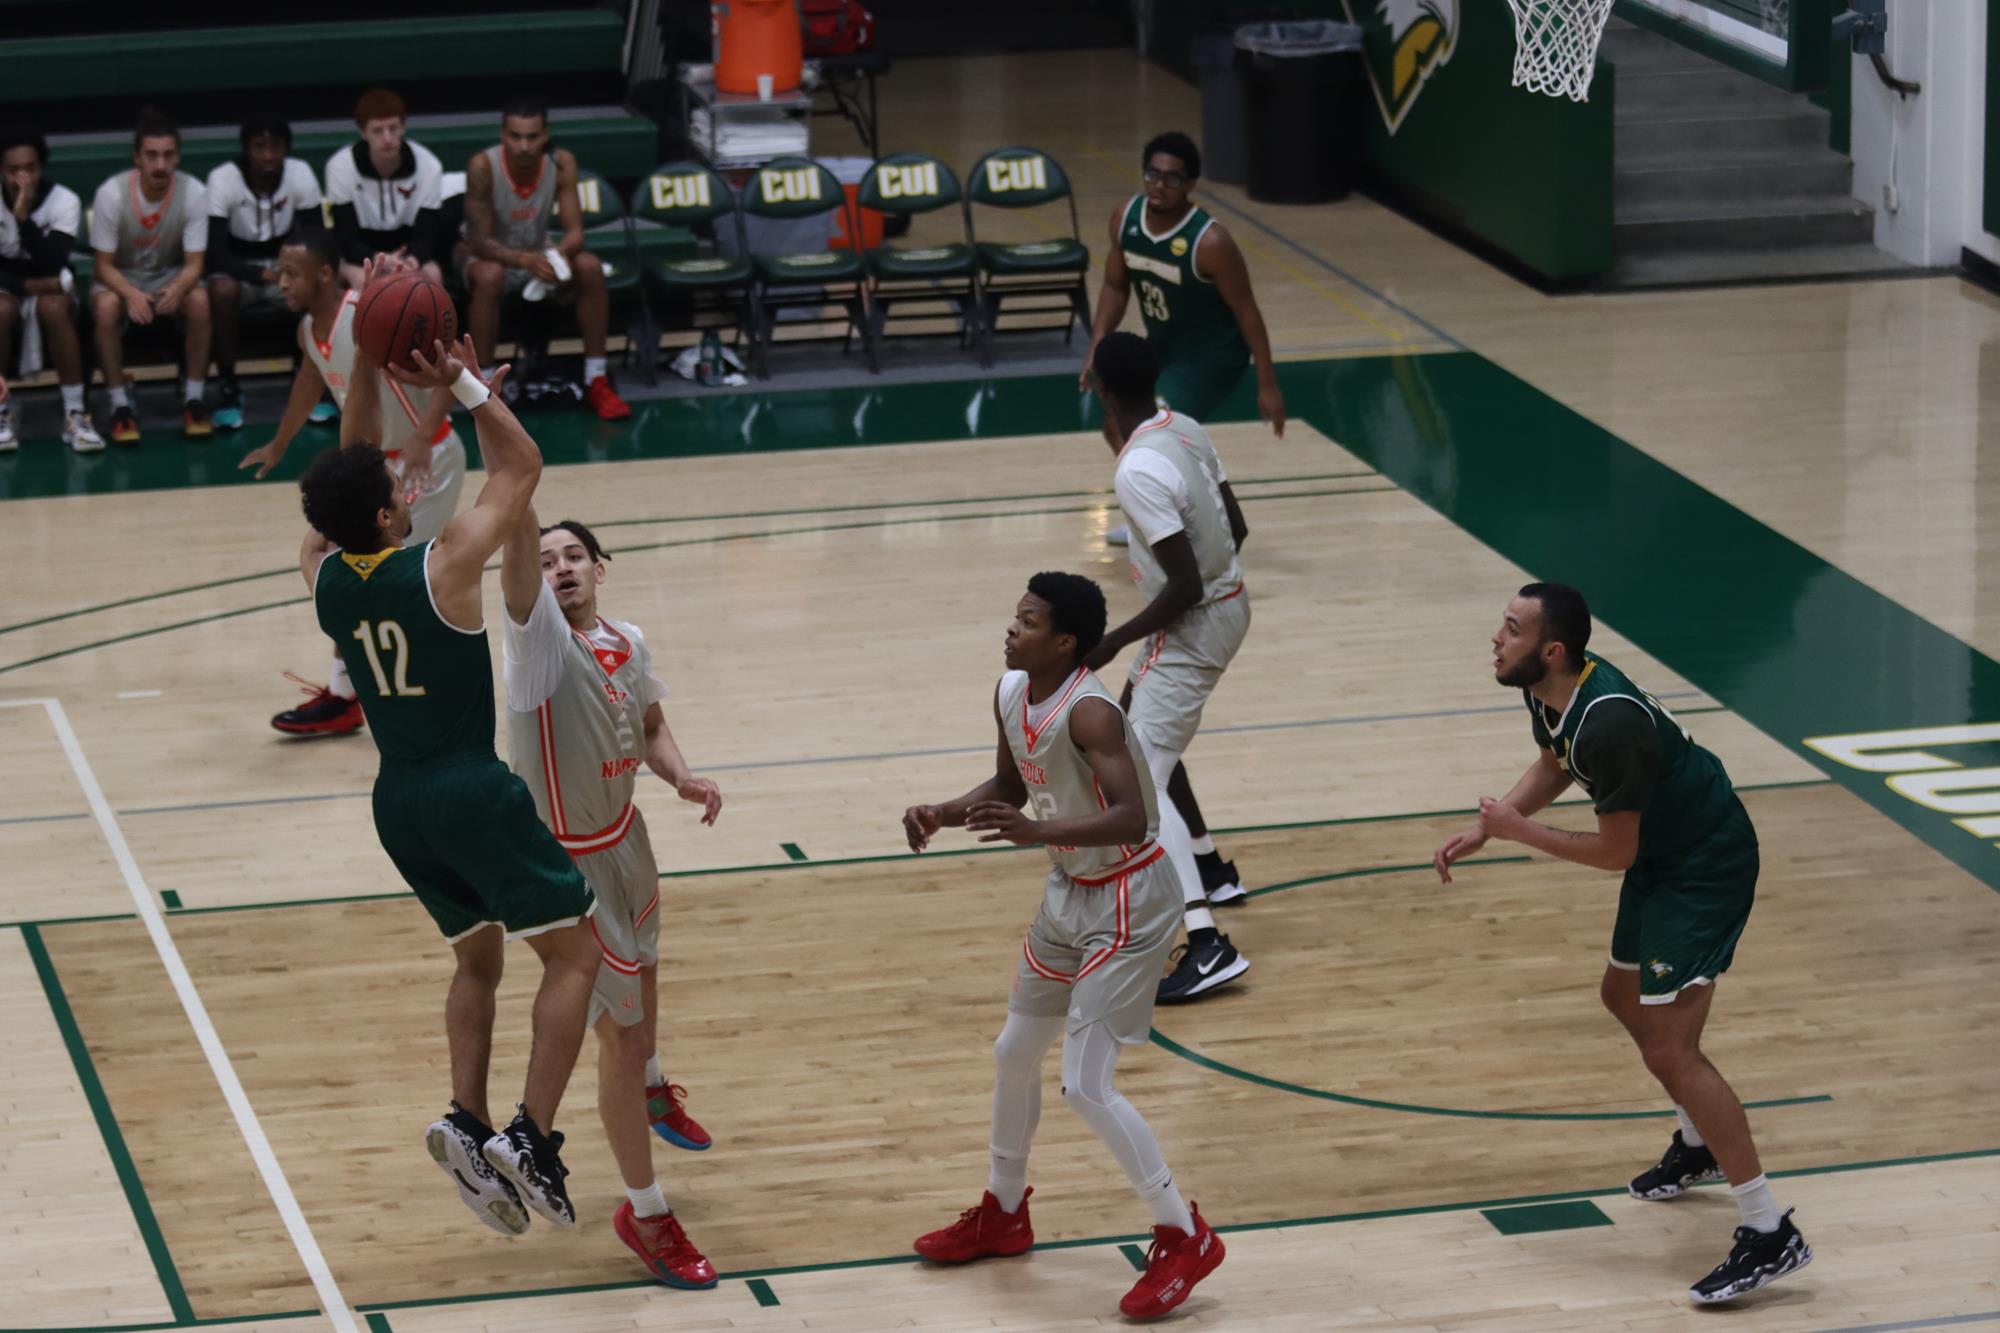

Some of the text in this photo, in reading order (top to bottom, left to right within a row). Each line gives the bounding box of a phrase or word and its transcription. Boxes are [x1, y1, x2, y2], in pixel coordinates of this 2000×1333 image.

[650, 172, 712, 209] CUI
[760, 166, 823, 203] CUI
[877, 161, 939, 198] CUI
[986, 155, 1048, 192] CUI
[353, 620, 425, 696] 12
[1019, 759, 1046, 785] HOLY
